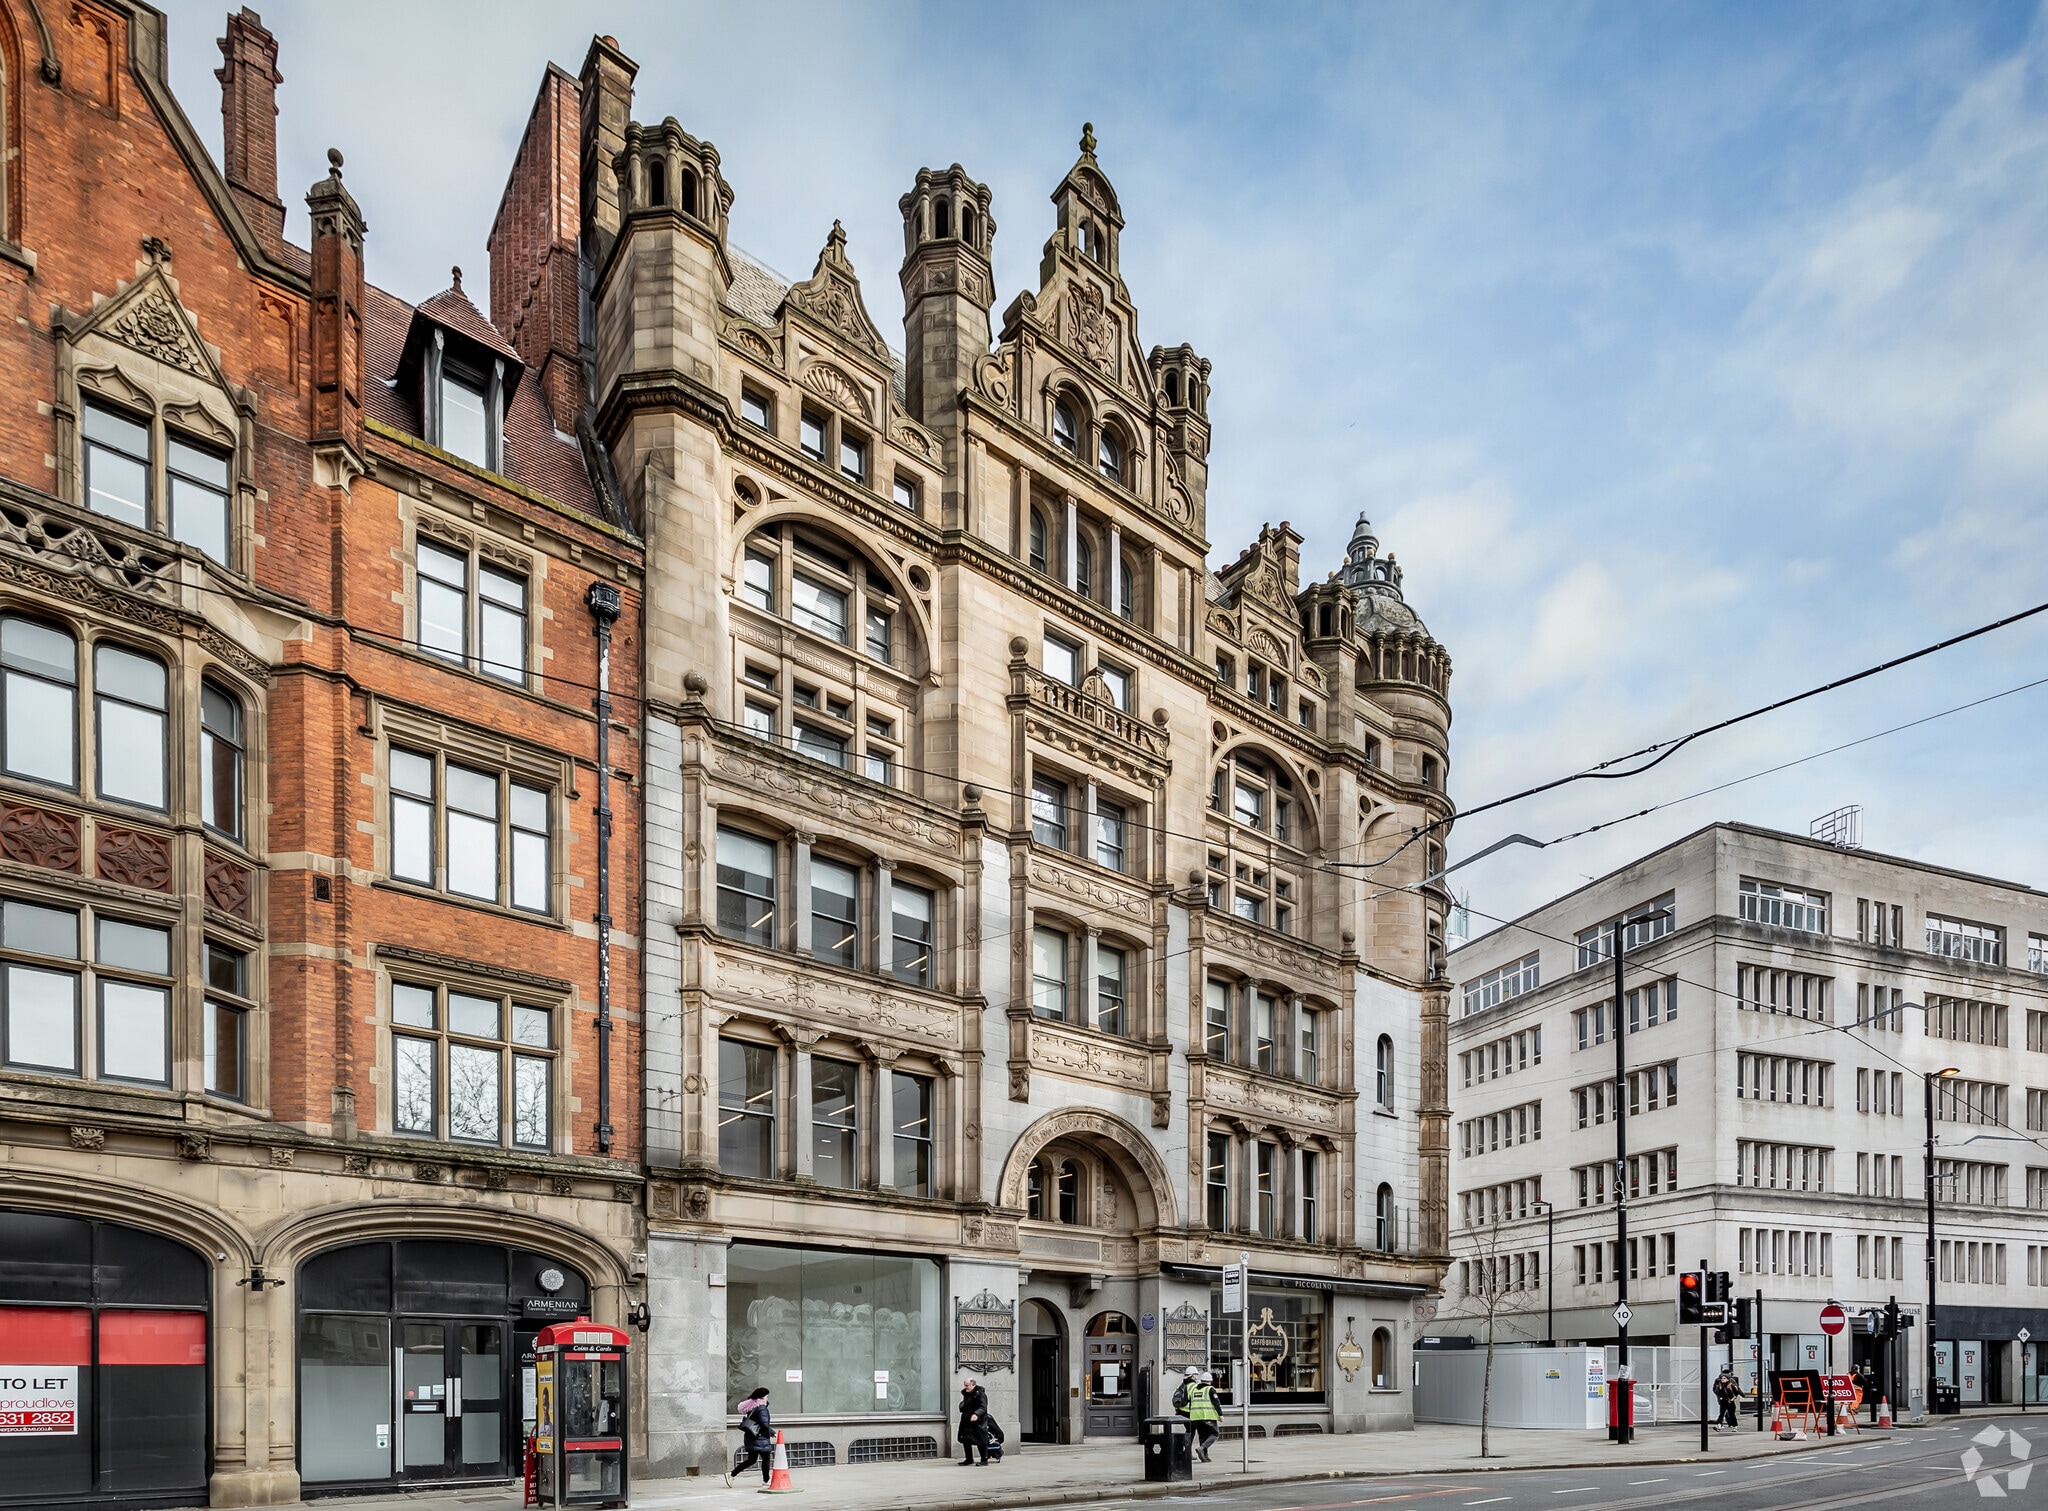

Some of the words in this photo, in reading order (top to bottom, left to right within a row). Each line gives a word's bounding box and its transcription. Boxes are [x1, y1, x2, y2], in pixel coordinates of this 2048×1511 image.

[1295, 1280, 1332, 1290] PICCOLINO
[526, 1300, 578, 1309] ARMENIAN
[961, 1313, 1011, 1328] NORTHERN
[1168, 1323, 1205, 1335] NORTHERN
[960, 1330, 1011, 1345] ASSURANCE
[961, 1347, 1010, 1362] BUILDINGS
[0, 1378, 27, 1389] TO
[33, 1378, 68, 1389] LET
[1822, 1389, 1852, 1397] COSED
[0, 1397, 75, 1410] proudlove
[0, 1412, 25, 1425] 631
[31, 1412, 71, 1424] 2852
